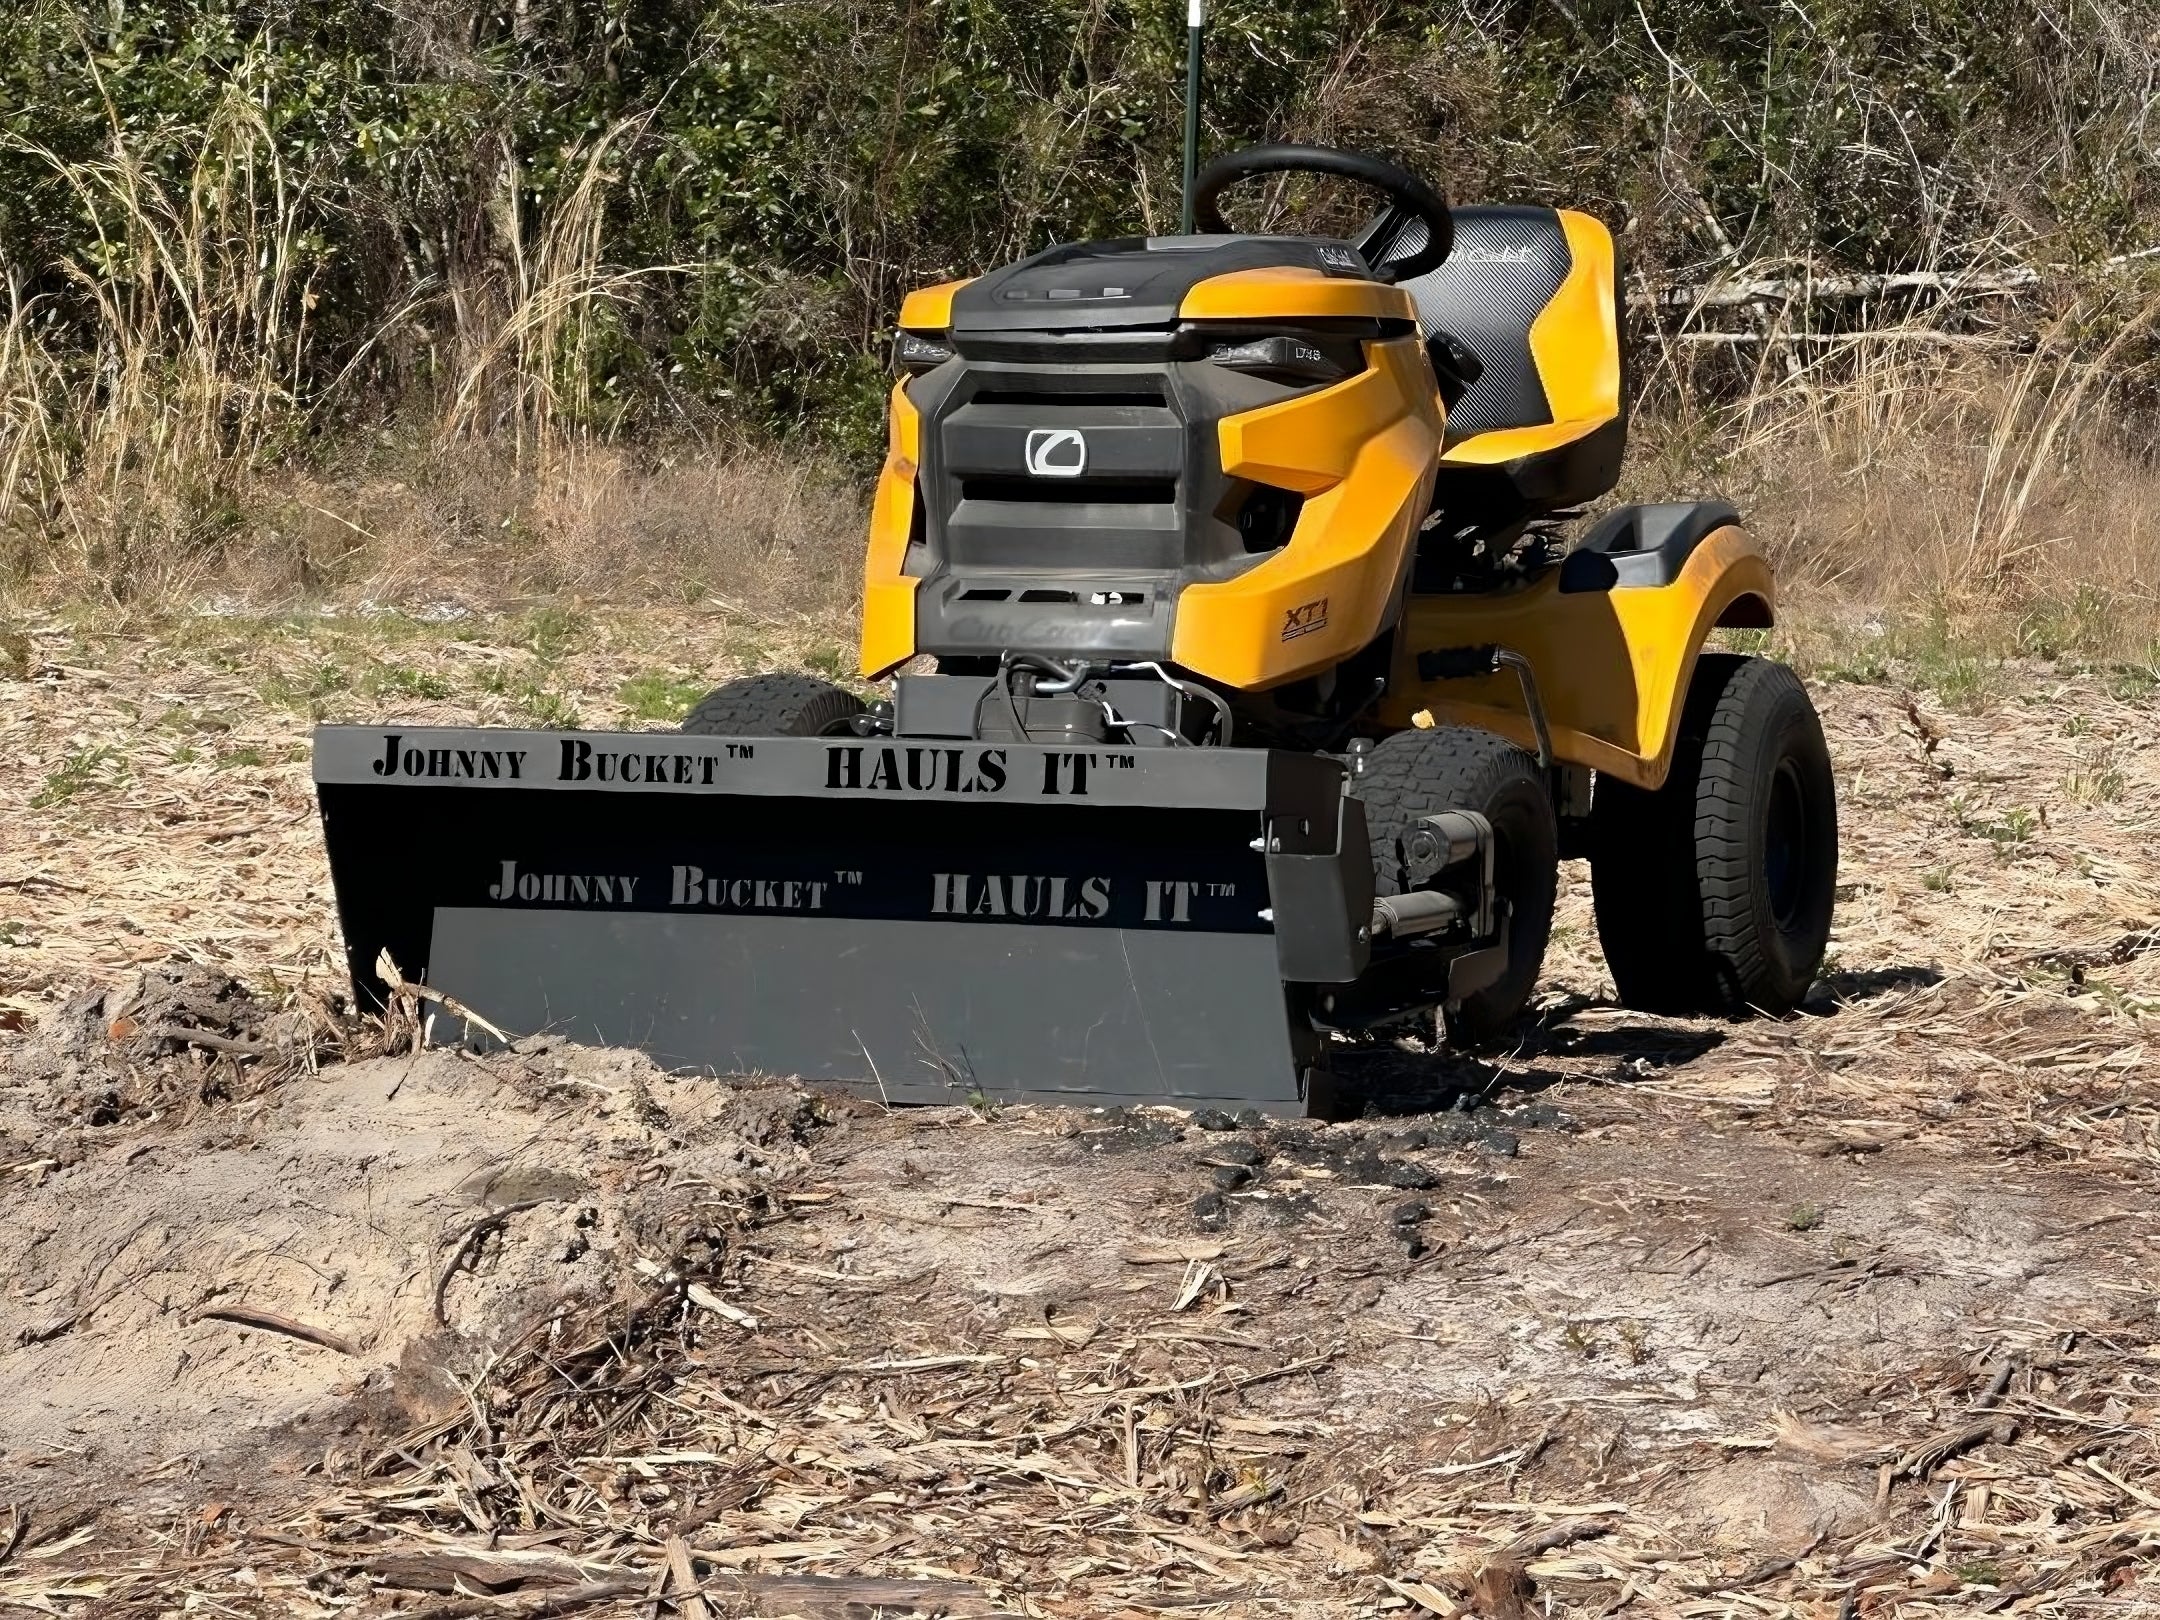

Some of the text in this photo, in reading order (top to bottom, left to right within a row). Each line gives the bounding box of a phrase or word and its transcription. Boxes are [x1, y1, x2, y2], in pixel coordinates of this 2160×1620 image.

[373, 735, 526, 778] JOHNNY
[825, 747, 1006, 792] HAULS
[931, 873, 1111, 919] HAULS
